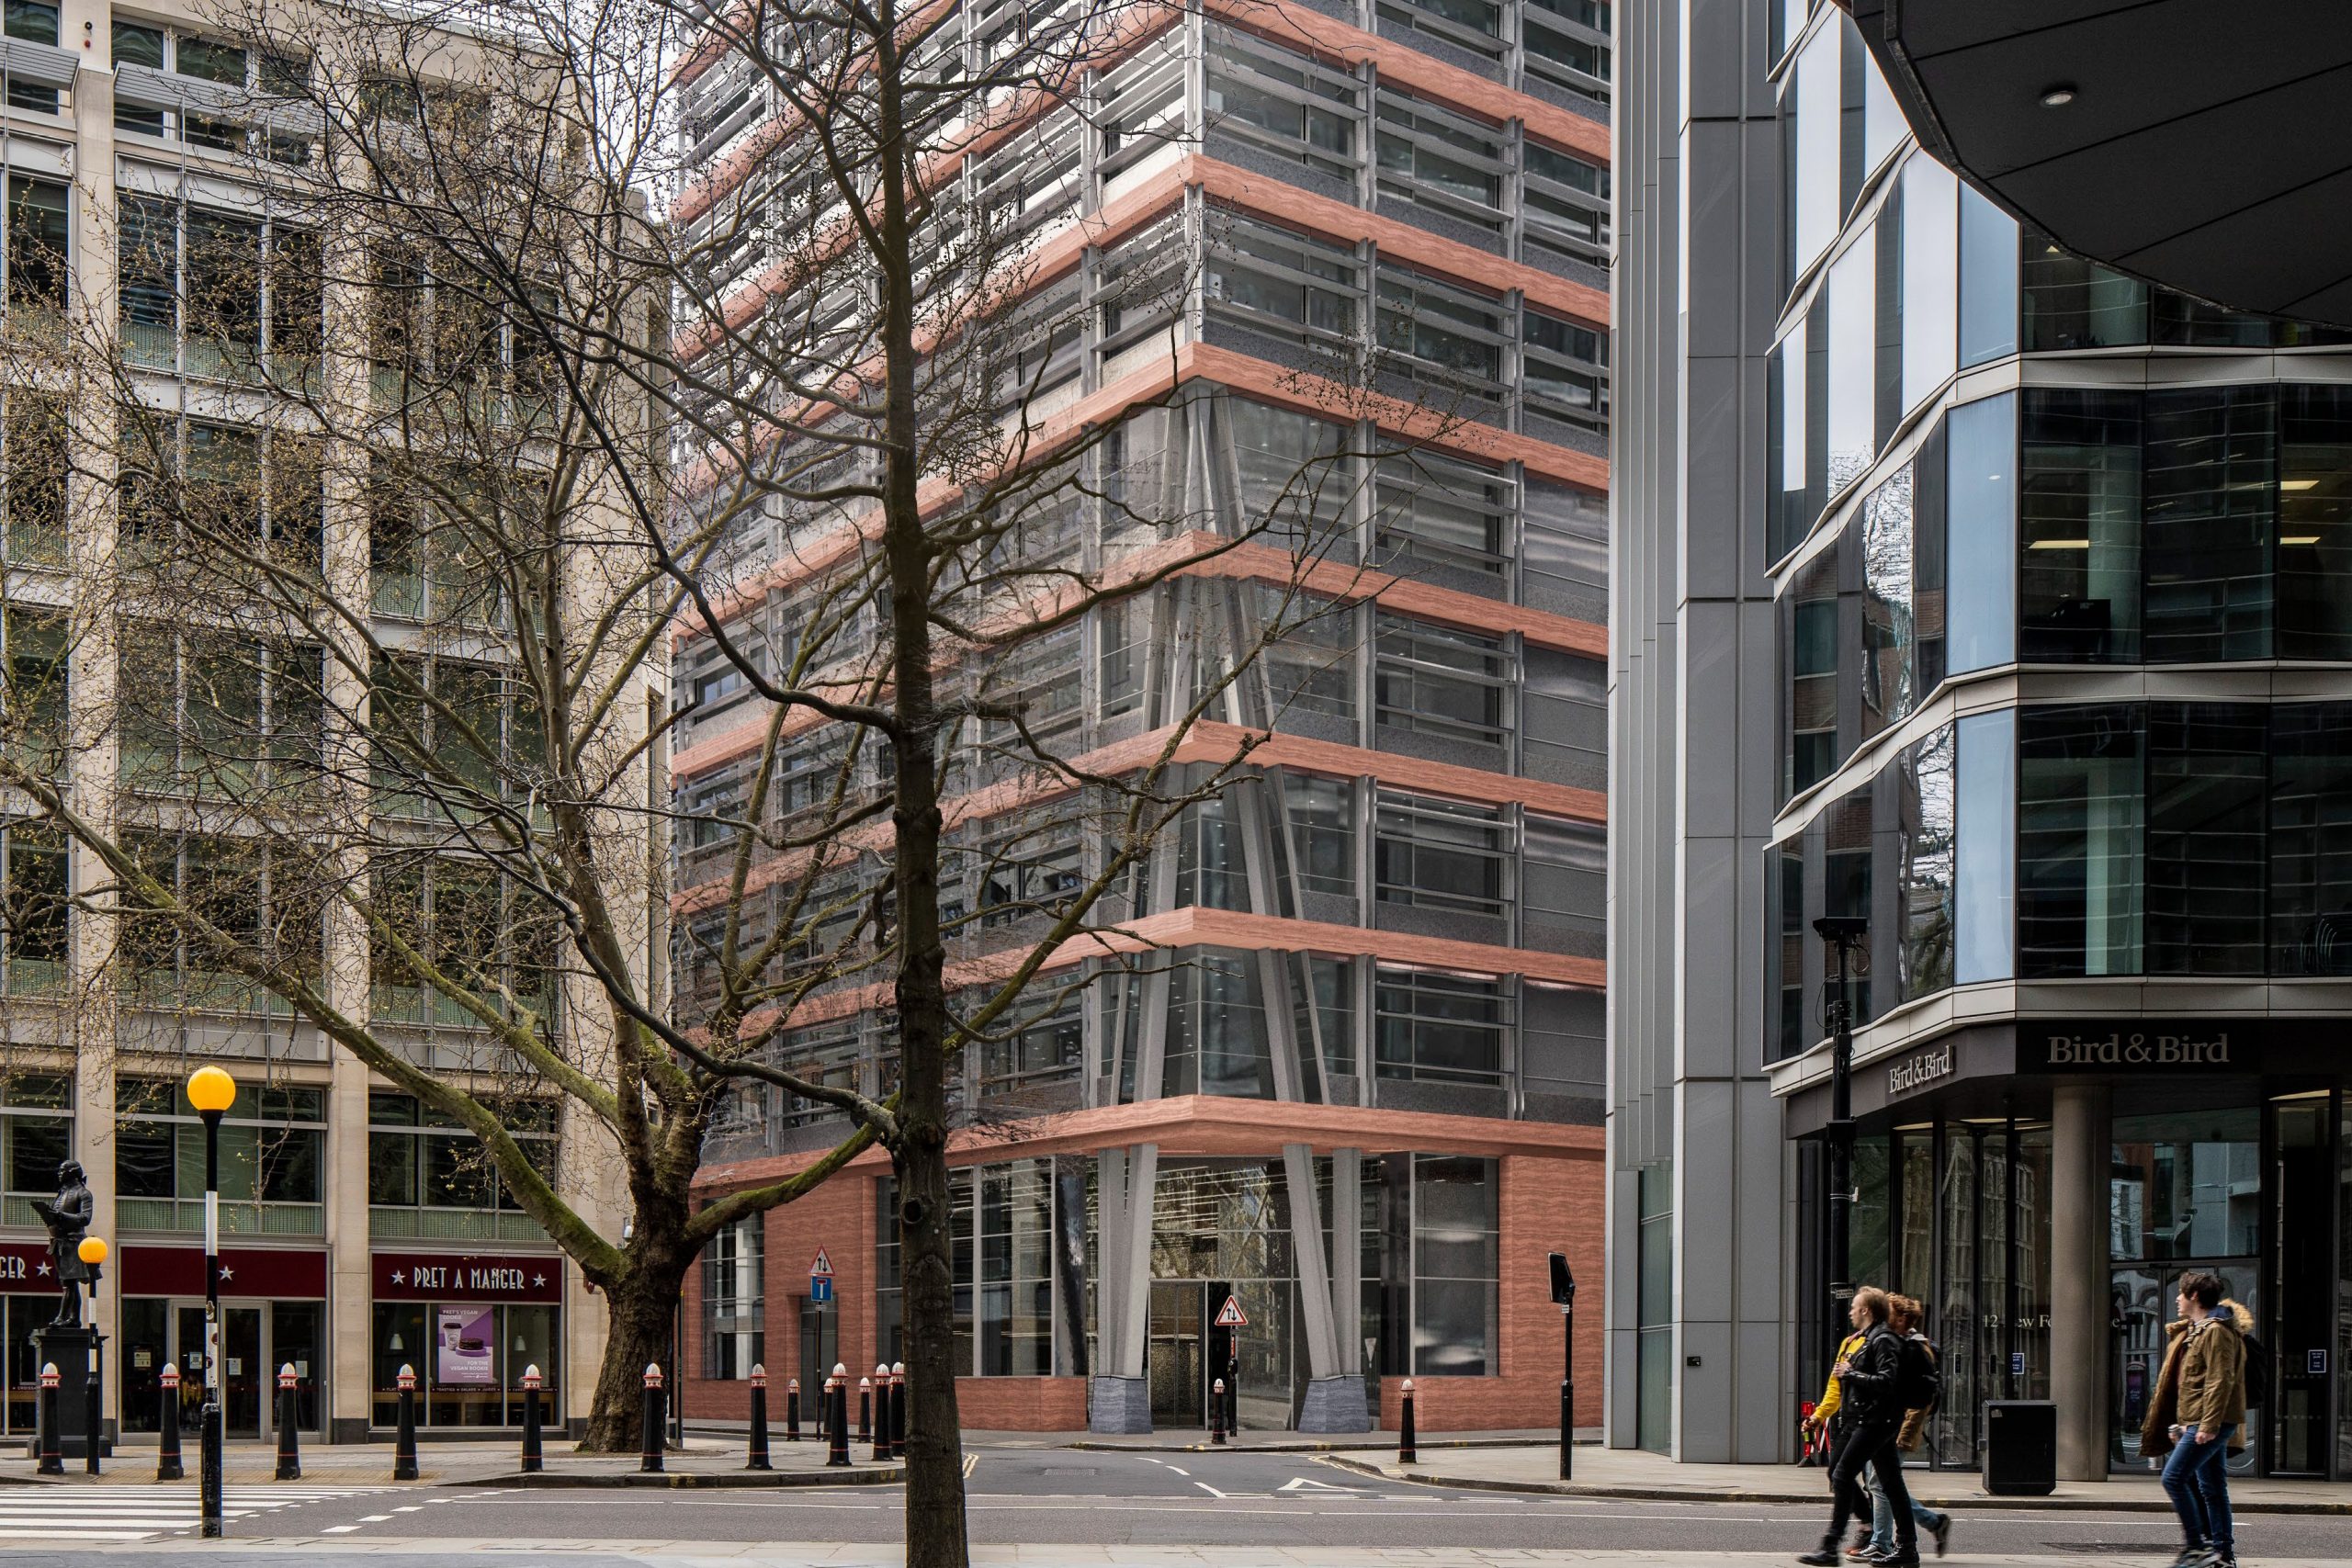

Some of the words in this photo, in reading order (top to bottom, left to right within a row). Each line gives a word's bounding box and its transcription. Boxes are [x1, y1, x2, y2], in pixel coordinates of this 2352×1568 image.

[413, 1267, 447, 1288] PRET
[455, 1269, 463, 1289] A
[470, 1268, 525, 1290] MANGER
[1984, 1314, 1998, 1328] 12
